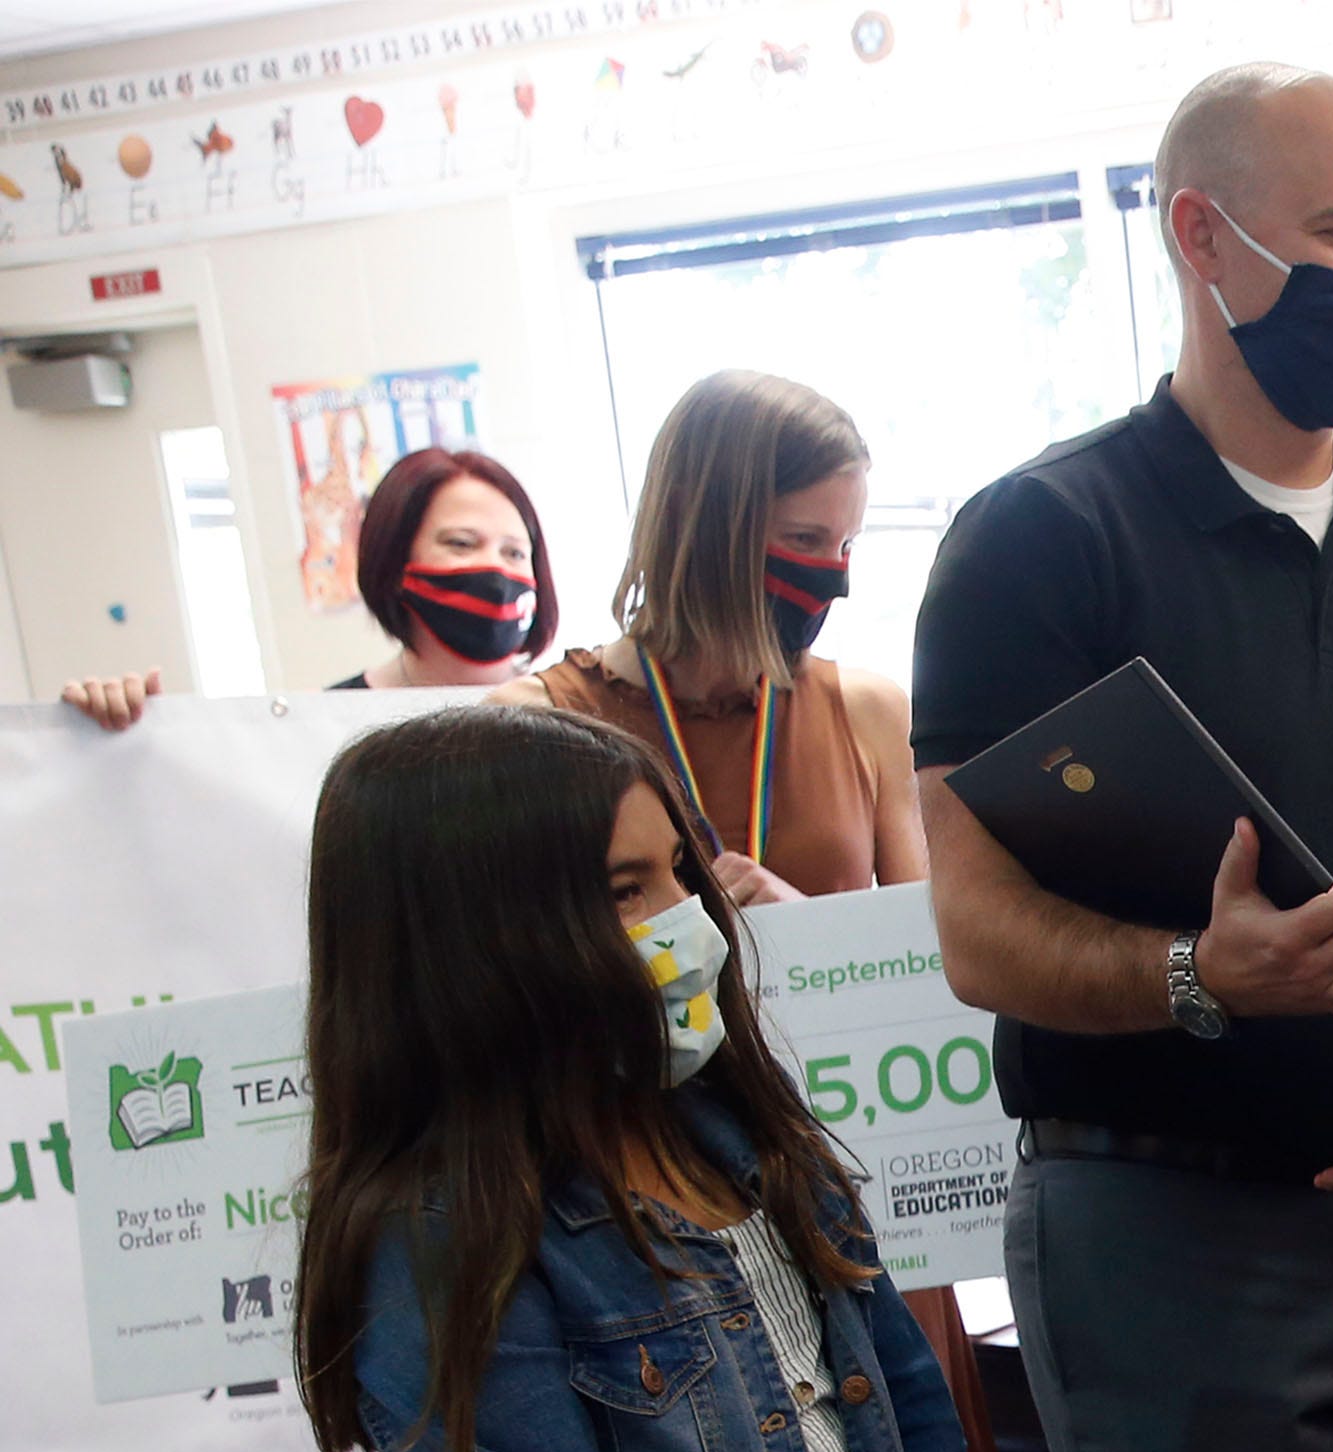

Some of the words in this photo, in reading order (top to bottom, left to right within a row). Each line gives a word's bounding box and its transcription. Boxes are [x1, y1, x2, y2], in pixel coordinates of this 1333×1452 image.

[889, 1142, 1004, 1177] OREGON
[891, 1173, 985, 1198] DEPARTMENT
[990, 1170, 1008, 1185] OF
[116, 1208, 149, 1229] Pay
[154, 1206, 172, 1222] to
[177, 1197, 206, 1217] the
[894, 1186, 1009, 1219] EDUCATION
[119, 1227, 174, 1251] Order
[178, 1221, 202, 1241] of:
